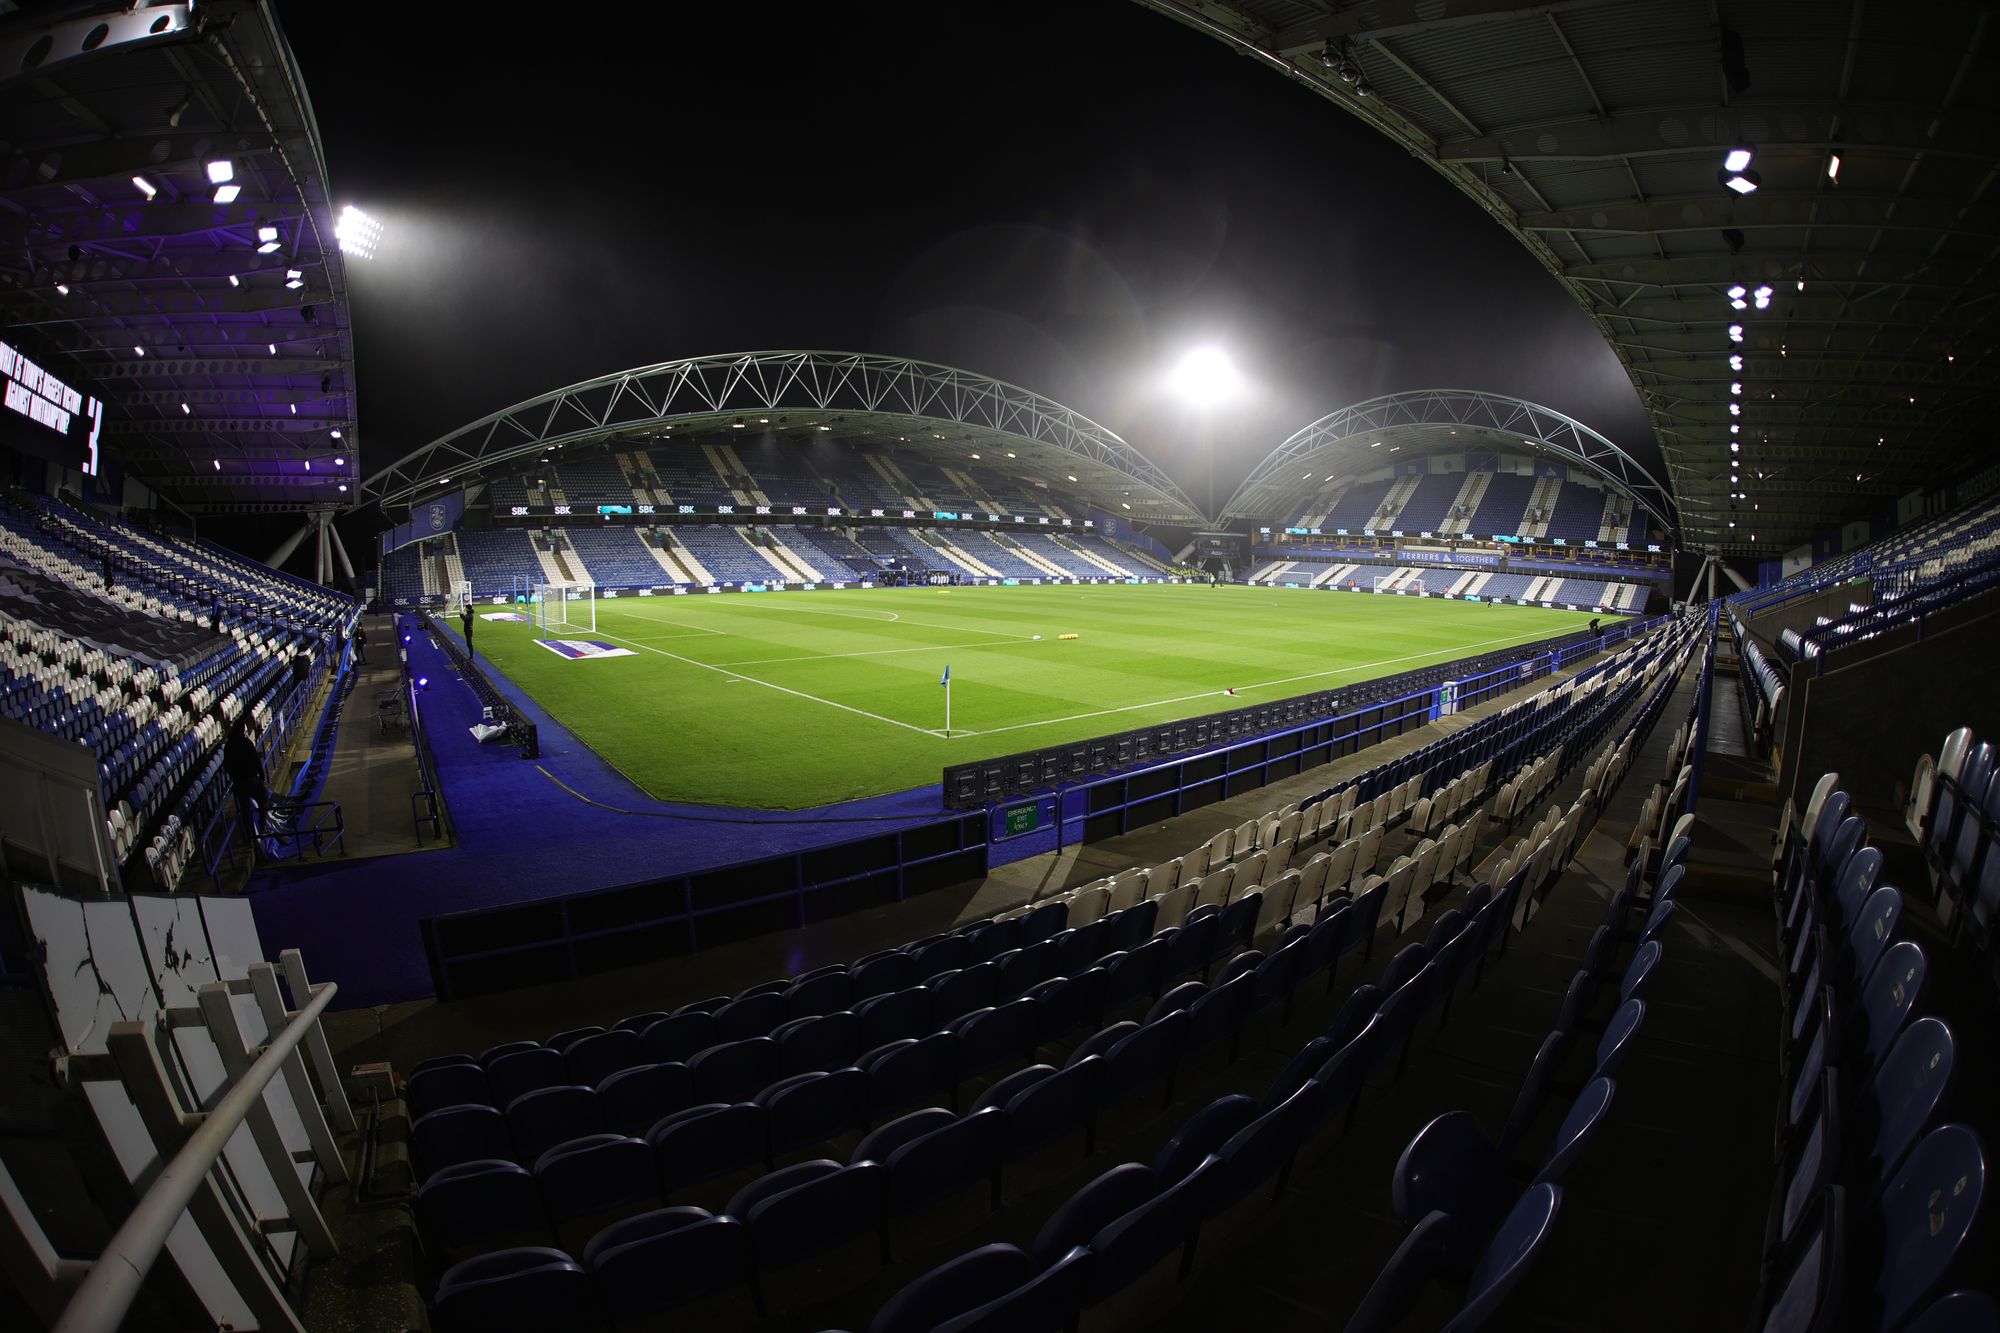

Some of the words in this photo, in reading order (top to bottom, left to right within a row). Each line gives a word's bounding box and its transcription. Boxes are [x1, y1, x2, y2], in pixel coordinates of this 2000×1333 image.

[1402, 552, 1439, 561] TERRIERS
[1456, 555, 1494, 563] TOGETHER
[1007, 805, 1037, 817] EMERGENCY
